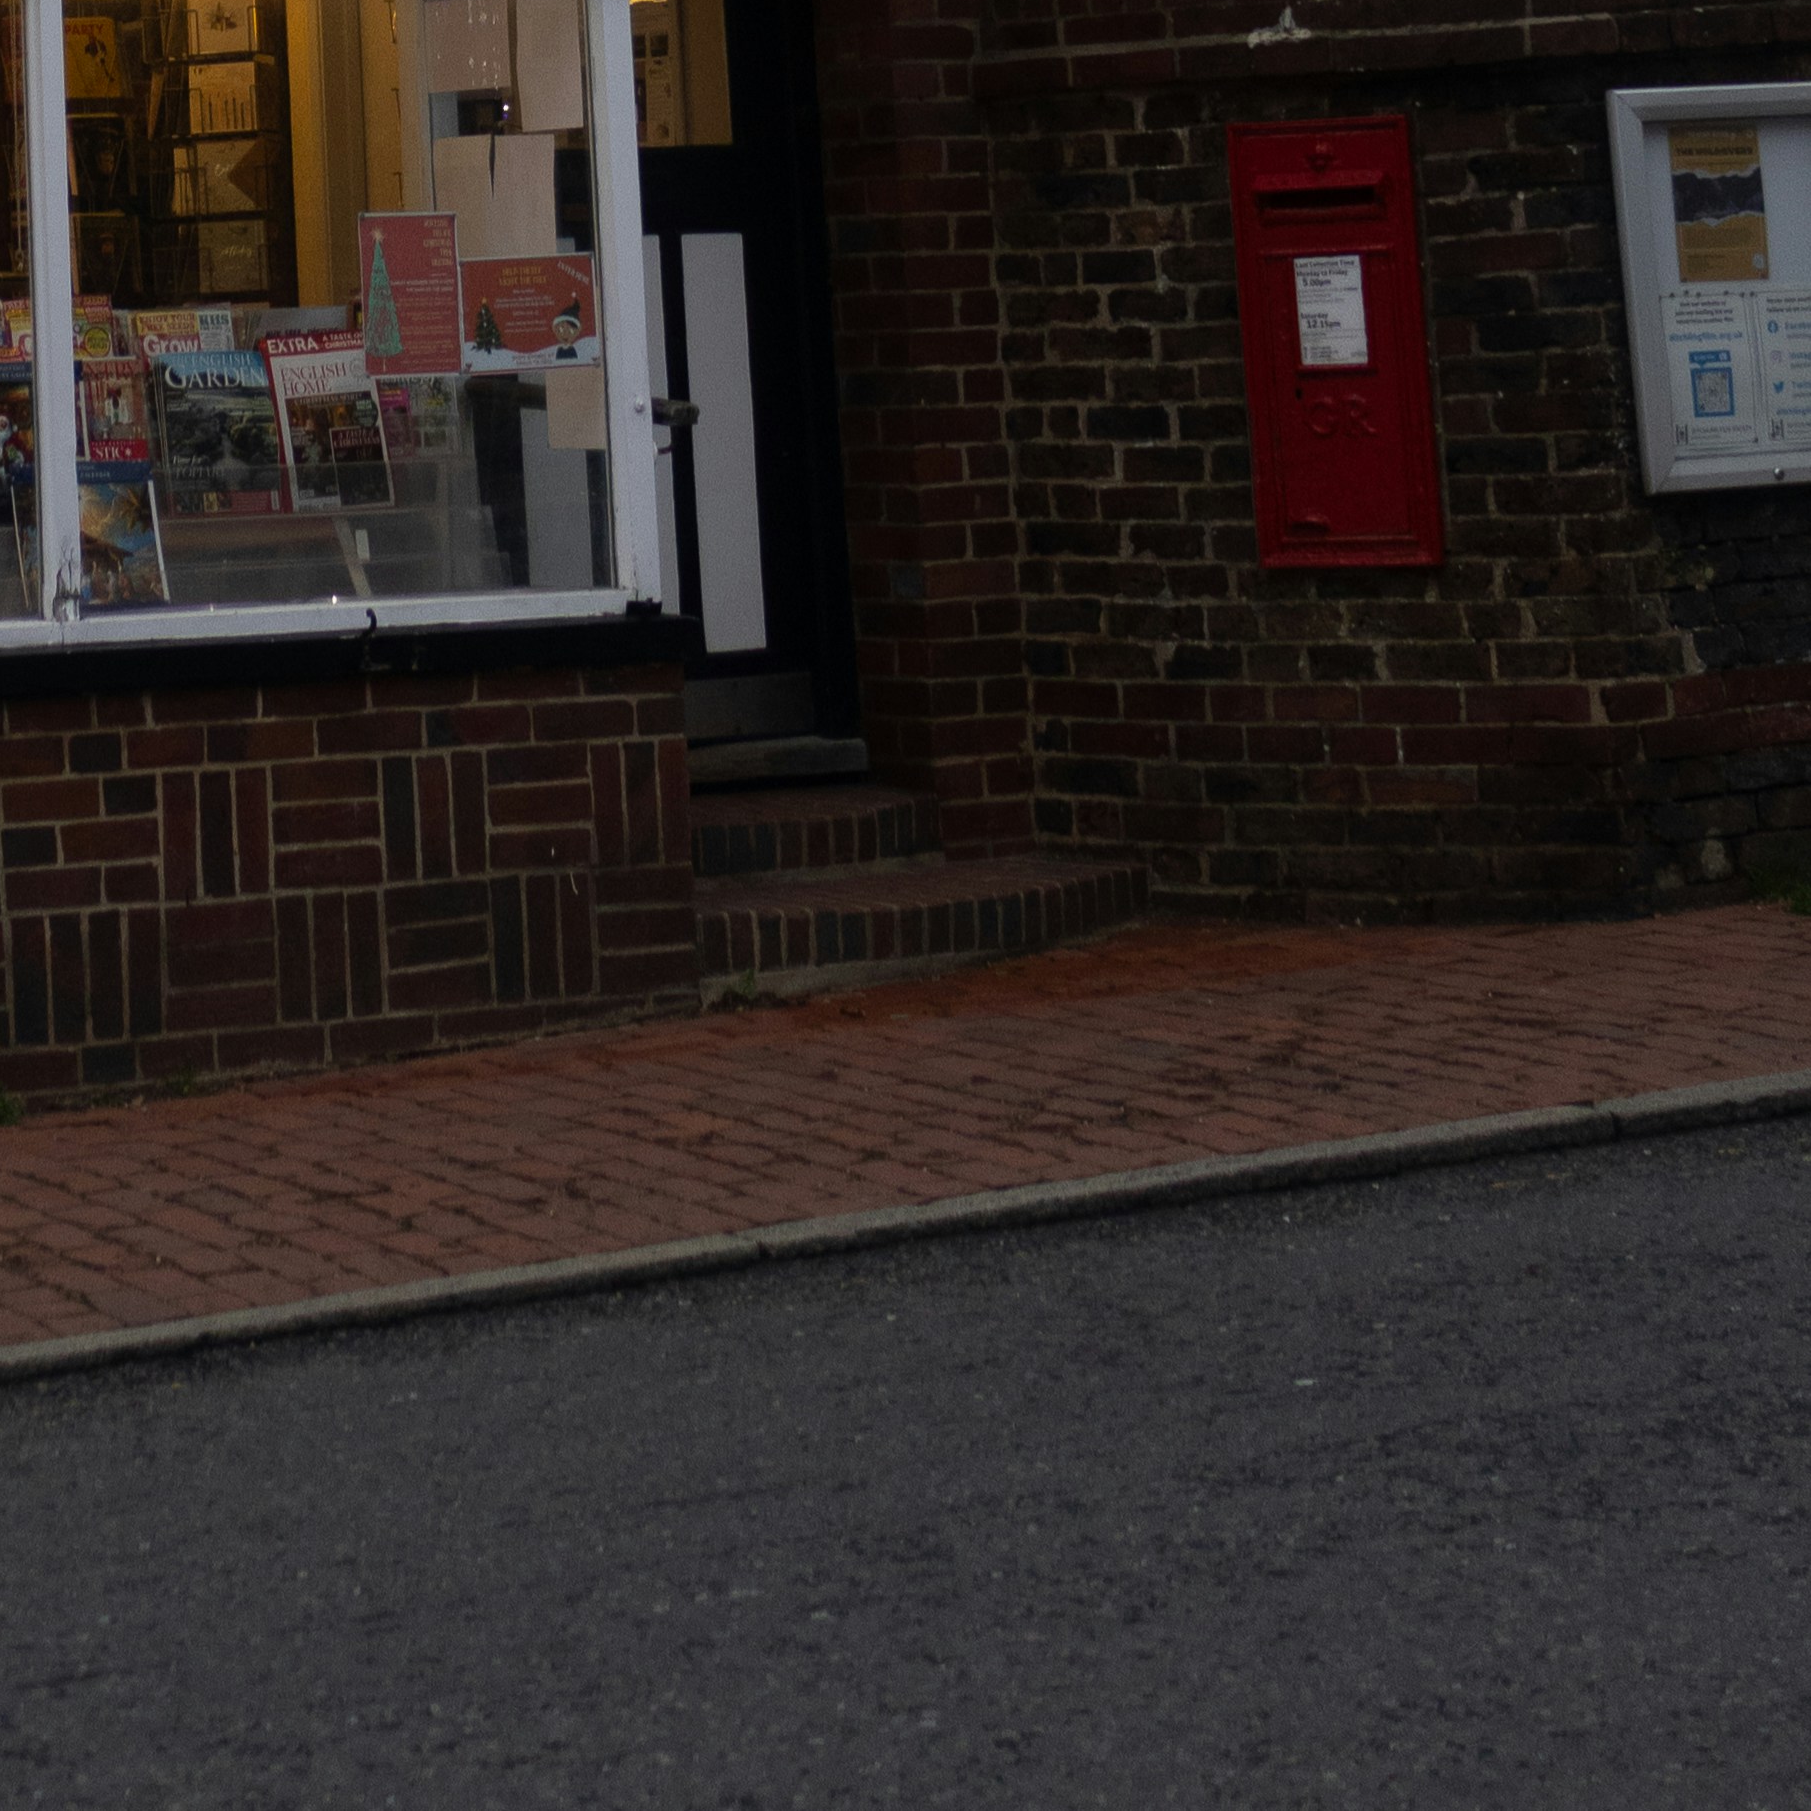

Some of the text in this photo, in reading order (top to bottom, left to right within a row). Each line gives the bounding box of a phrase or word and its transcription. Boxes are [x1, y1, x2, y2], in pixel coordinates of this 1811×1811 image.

[143, 333, 200, 358] Grow
[266, 336, 319, 354] EXTRA
[322, 334, 328, 342] A
[330, 332, 352, 341] TASTE
[324, 338, 364, 350] CHRISTMA
[191, 353, 253, 367] ENGLISH
[165, 363, 266, 389] GARDEN
[279, 361, 348, 382] ENGLISH
[283, 377, 333, 397] HOME
